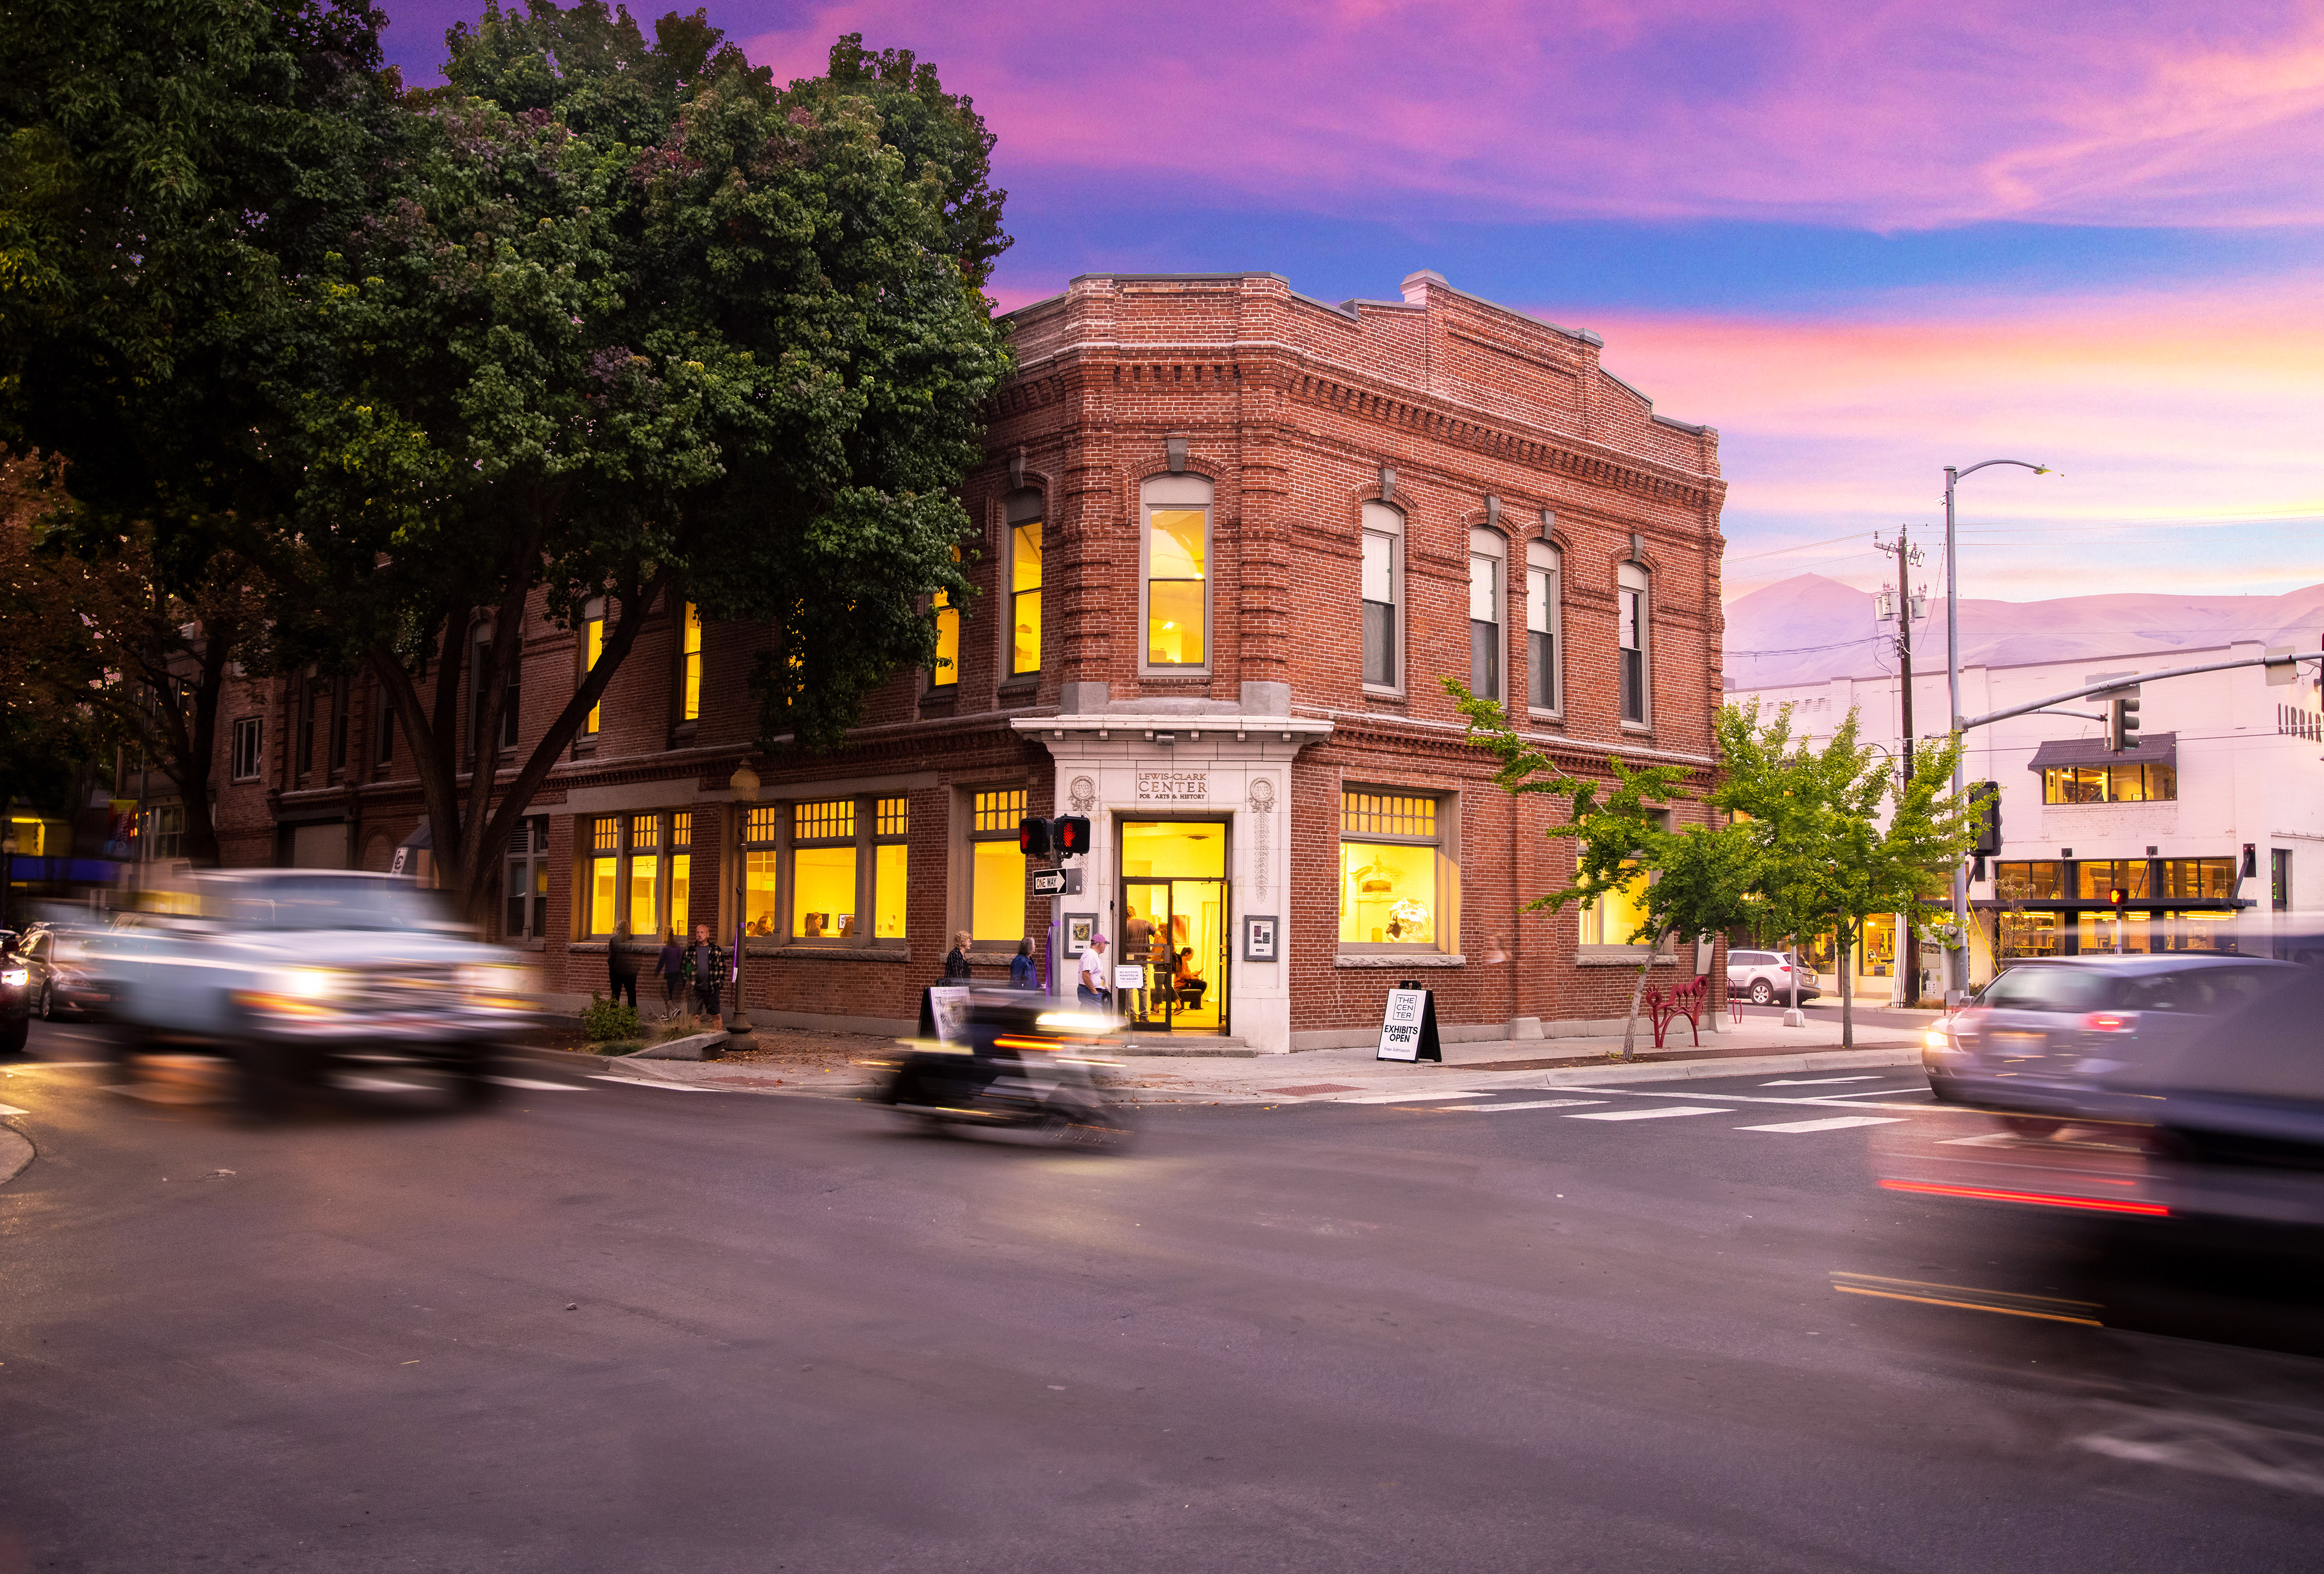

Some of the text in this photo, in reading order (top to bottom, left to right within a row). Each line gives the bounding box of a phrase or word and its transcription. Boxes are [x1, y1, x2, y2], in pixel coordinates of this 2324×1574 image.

[2278, 703, 2324, 743] LIBRAR
[1139, 781, 1207, 793] CENTER
[1037, 877, 1057, 888] ONE WAY
[1385, 1025, 1418, 1035] EXHIBITS
[1390, 1034, 1410, 1042] OPEN
